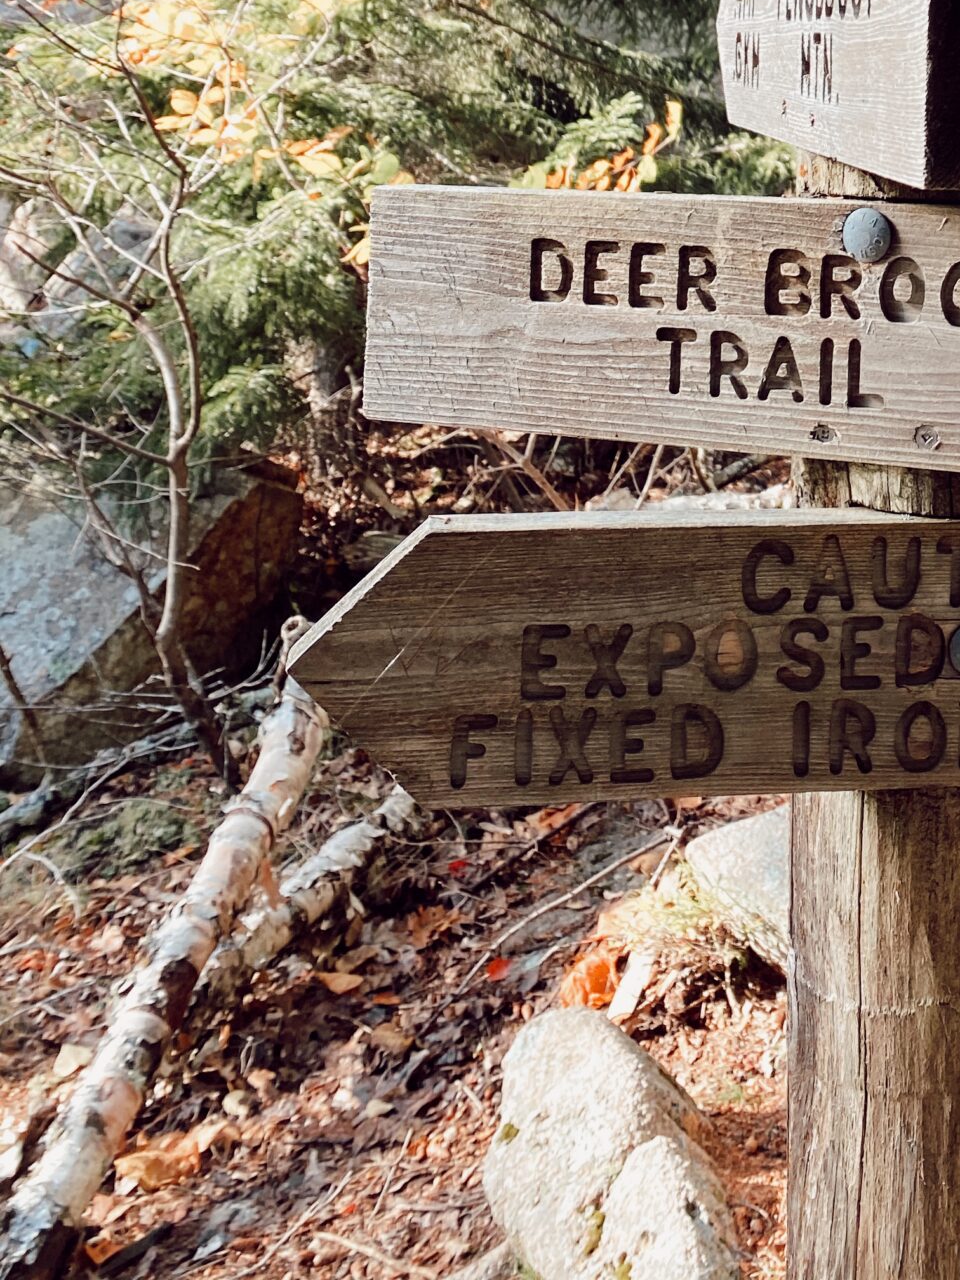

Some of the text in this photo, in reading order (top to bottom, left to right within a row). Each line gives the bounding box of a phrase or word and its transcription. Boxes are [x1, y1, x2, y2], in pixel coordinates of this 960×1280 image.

[529, 237, 718, 312] DEER
[655, 326, 885, 409] TRAIL
[520, 613, 945, 701] EXPOSED
[449, 703, 724, 790] FIXED
